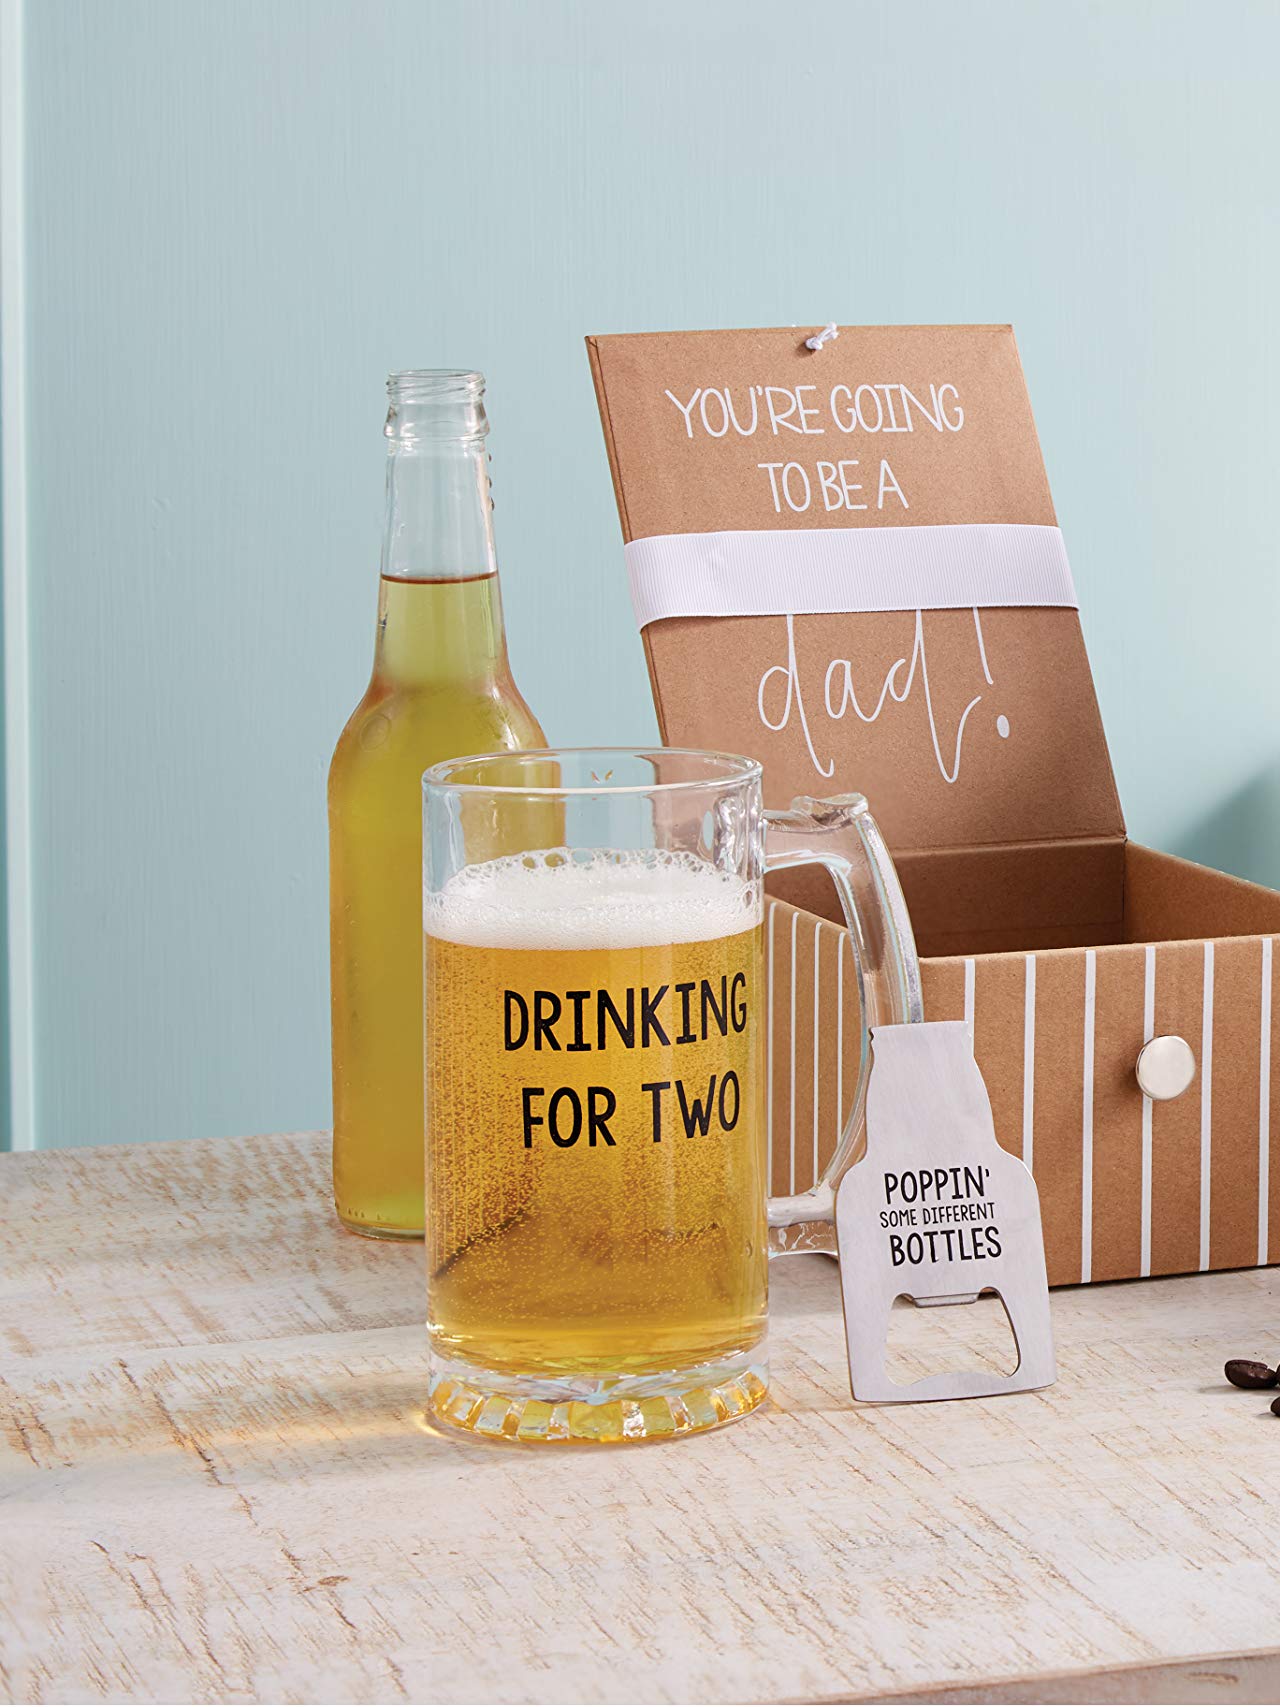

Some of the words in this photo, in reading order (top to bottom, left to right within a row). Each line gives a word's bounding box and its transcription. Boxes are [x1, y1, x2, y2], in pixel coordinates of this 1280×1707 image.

[665, 385, 825, 438] YOU'RE
[829, 383, 965, 433] GOING
[757, 462, 810, 512] TO
[816, 460, 868, 511] BE
[876, 459, 910, 509] A
[504, 972, 748, 1052] DRINKING
[521, 1085, 617, 1149] FOR
[641, 1070, 740, 1144] TWO
[884, 1165, 990, 1205] POPPIN'
[880, 1208, 918, 1228] SOME
[922, 1203, 995, 1225] DIFFERENT
[889, 1226, 1002, 1267] BOTTLES
